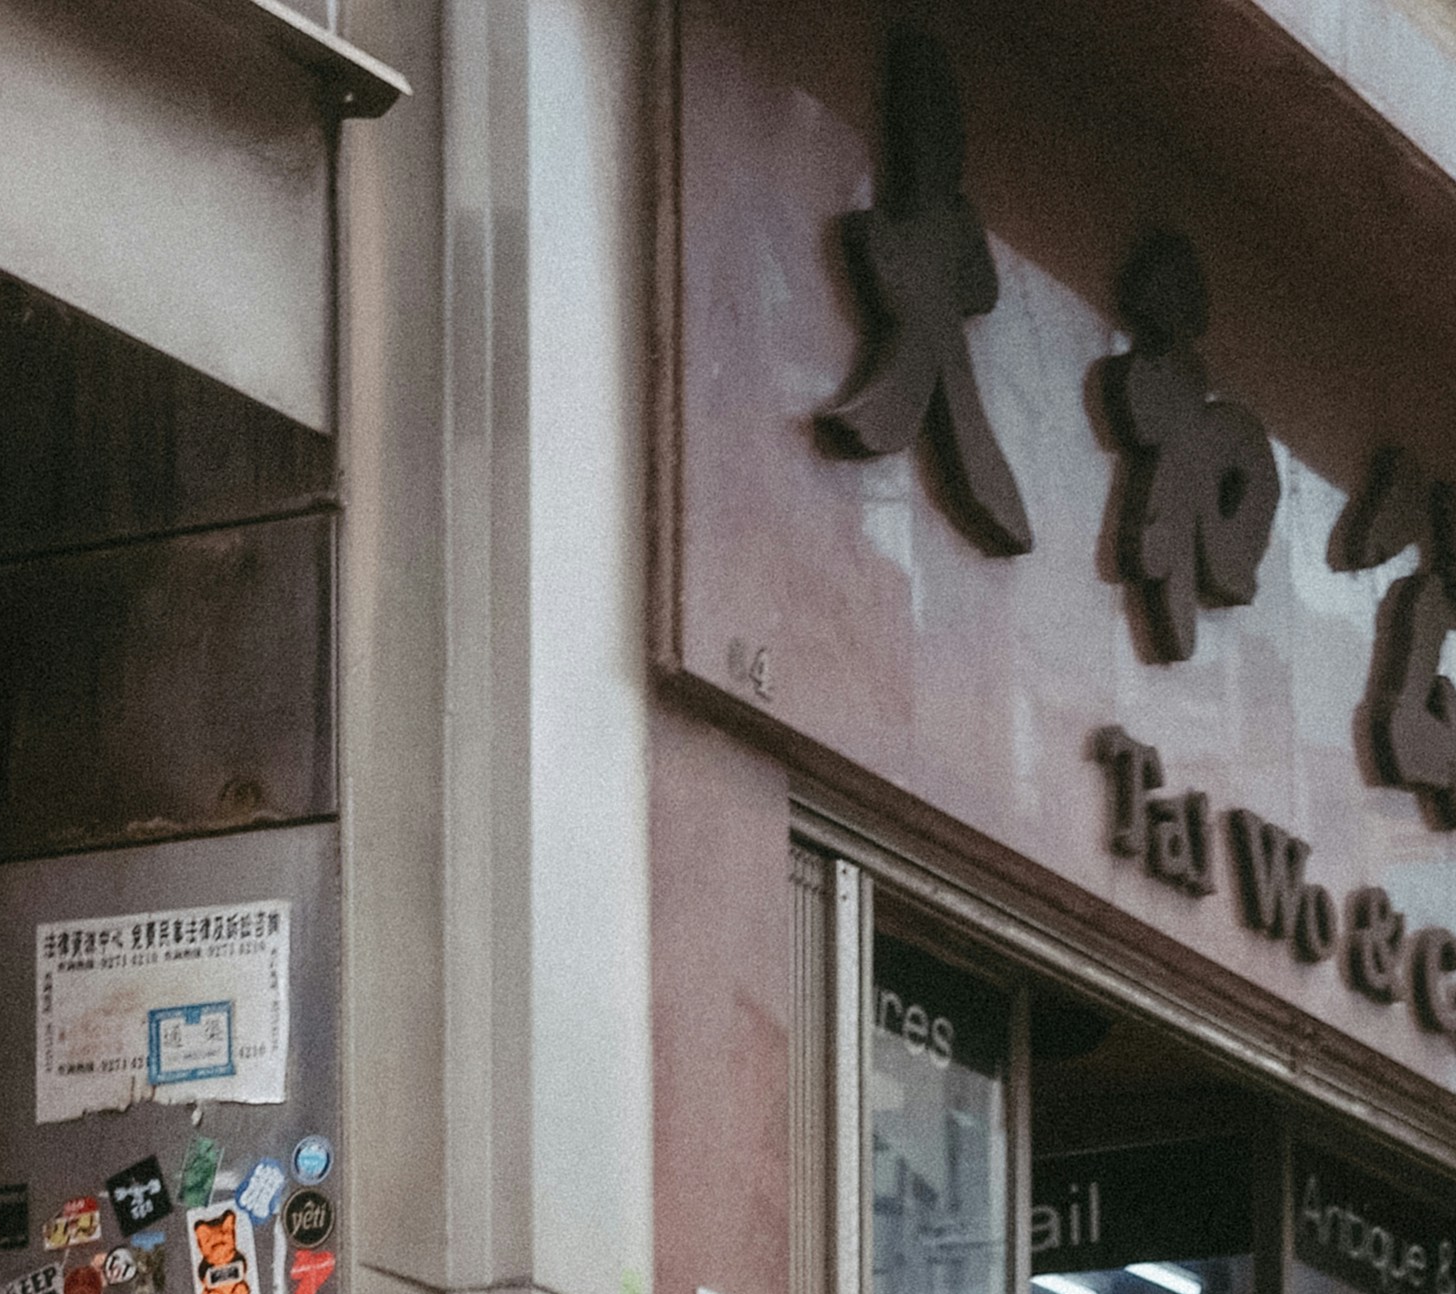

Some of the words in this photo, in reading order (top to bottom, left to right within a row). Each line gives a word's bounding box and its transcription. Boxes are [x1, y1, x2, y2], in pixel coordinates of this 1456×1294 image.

[1085, 725, 1215, 897] Tai
[1220, 809, 1337, 964] Wo
[1337, 886, 1405, 1006] &
